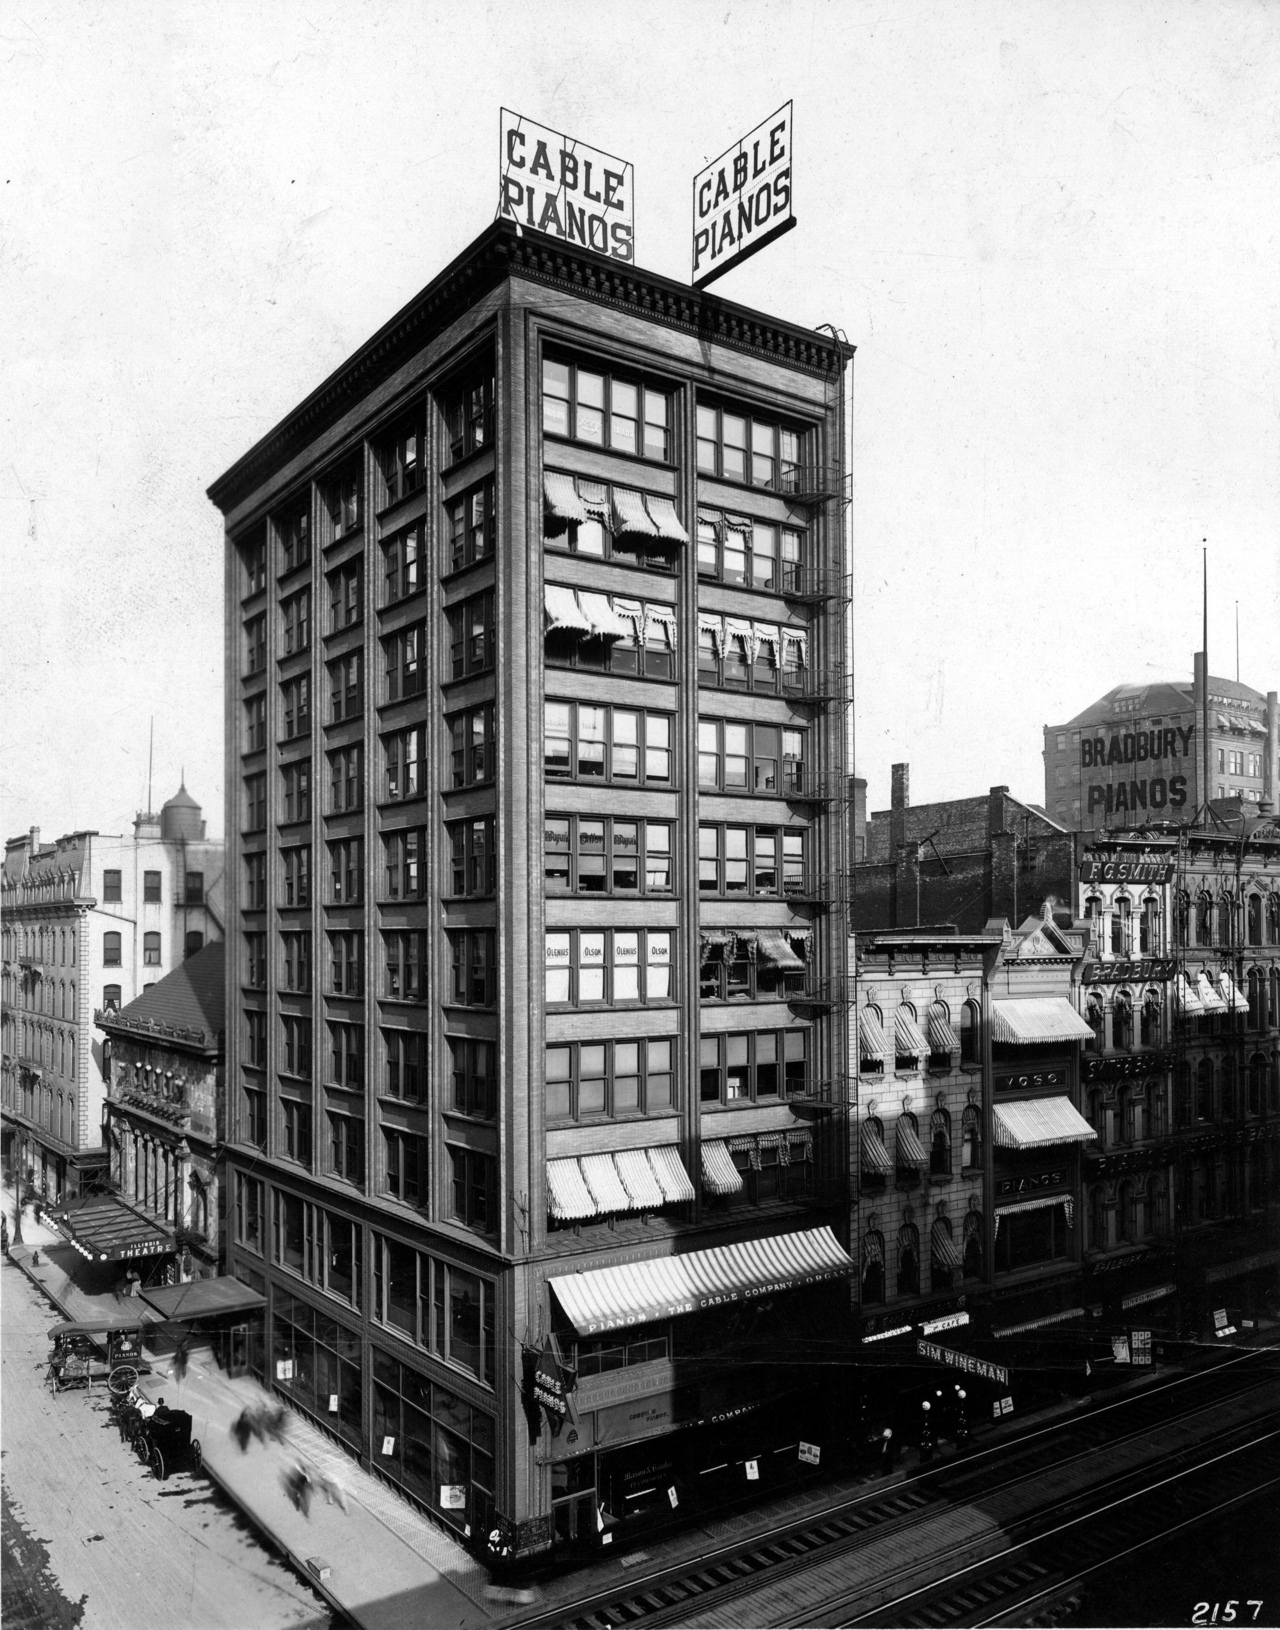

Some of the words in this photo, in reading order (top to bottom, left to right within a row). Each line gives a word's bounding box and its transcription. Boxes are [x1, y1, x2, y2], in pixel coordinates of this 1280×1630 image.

[507, 128, 624, 211] CABLE
[699, 120, 786, 218] CABLE
[502, 174, 633, 261] PIANOS
[693, 167, 791, 271] PIANOS
[612, 425, 634, 438] TAILOR
[1081, 724, 1195, 768] BRADBURY
[1088, 775, 1187, 814] PIANOS
[1089, 862, 1102, 879] F.
[1103, 863, 1115, 879] G.
[1116, 863, 1169, 880] SMITH
[1090, 961, 1174, 981] BRADBURY
[120, 1244, 172, 1258] THEATRE
[130, 1240, 160, 1249] ILLINOIS
[588, 1313, 647, 1332] PIANOS
[668, 1303, 692, 1315] THE
[700, 1292, 739, 1307] CABLE
[744, 1281, 793, 1298] COMPANY
[805, 1268, 855, 1284] ORGANS
[918, 1341, 941, 1360] SIM
